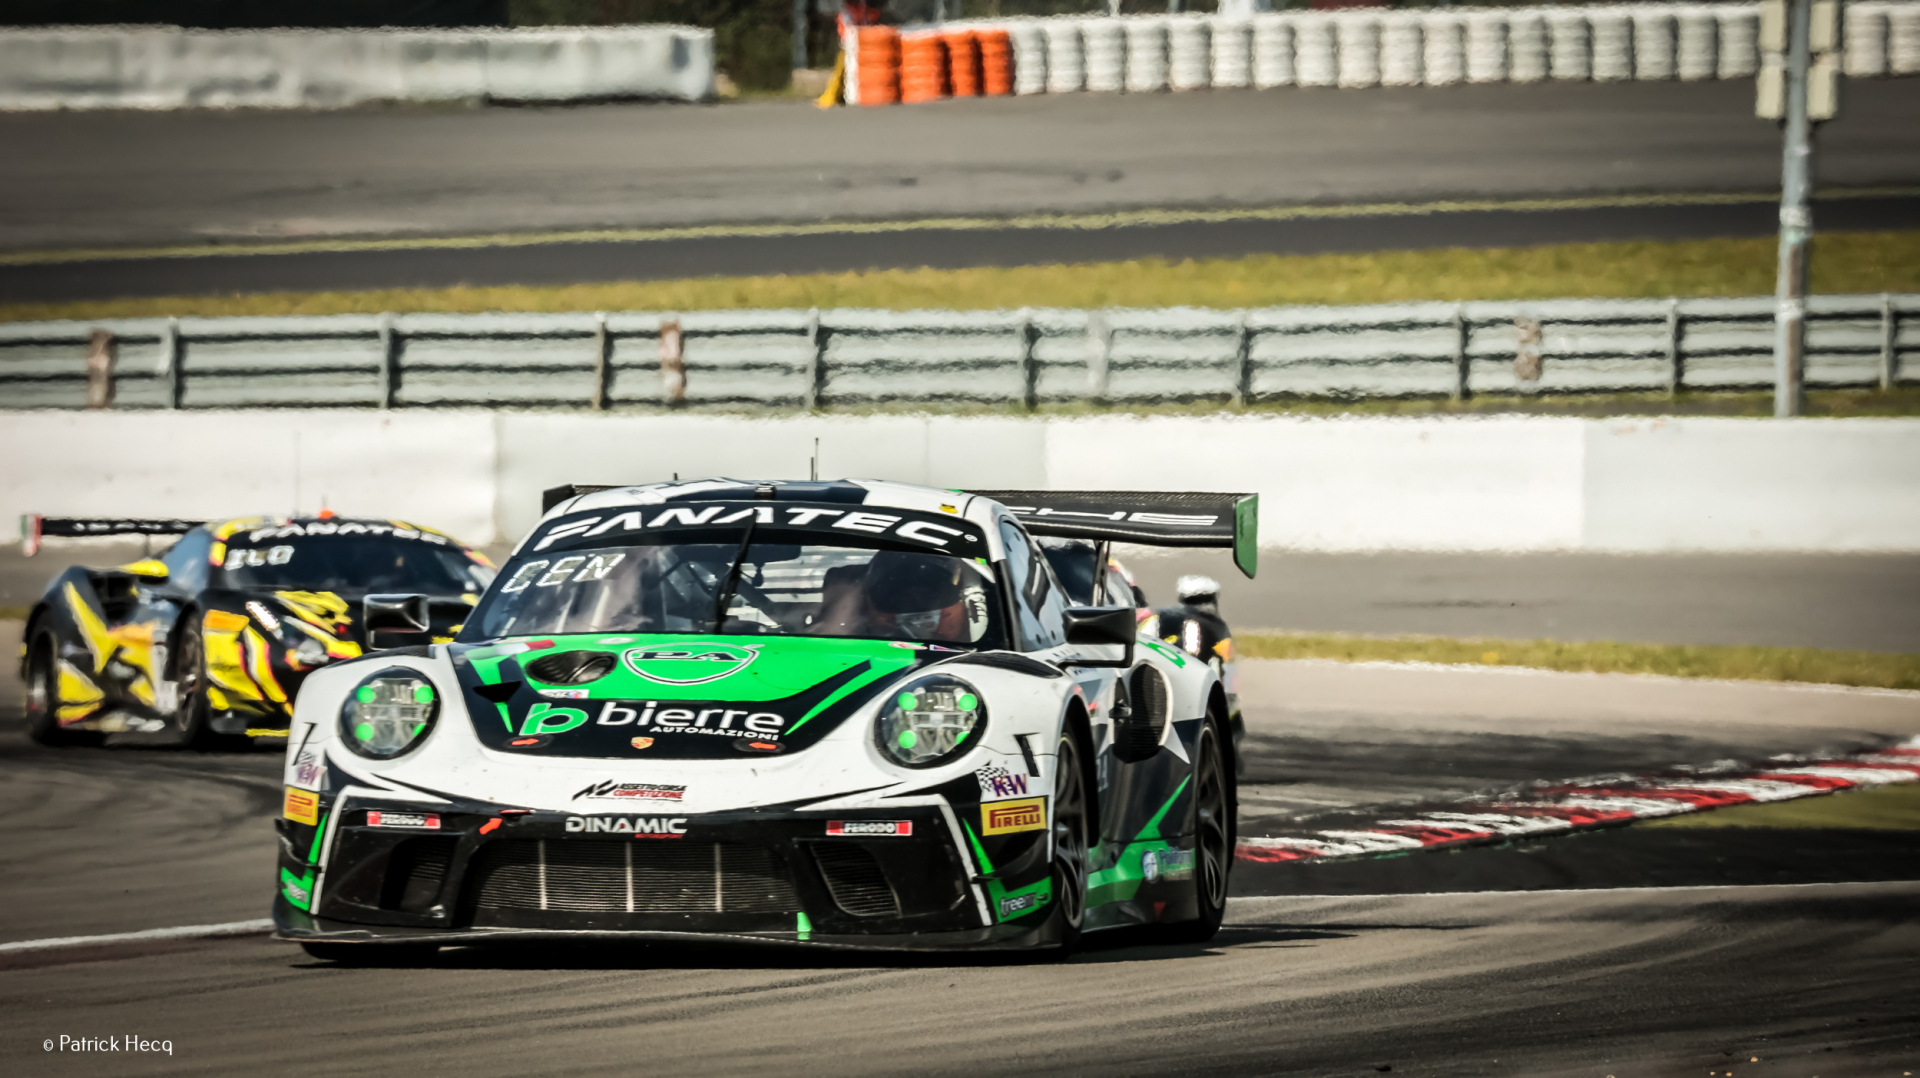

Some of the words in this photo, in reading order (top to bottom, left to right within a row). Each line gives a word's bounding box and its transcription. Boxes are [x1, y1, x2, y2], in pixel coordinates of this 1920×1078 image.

[250, 522, 447, 546] FANATEC
[533, 506, 964, 552] FANATEC
[596, 701, 785, 733] bierre
[649, 726, 779, 741] AUTOMAZIONI
[990, 774, 1028, 797] KW
[565, 816, 688, 834] DINAMIC
[843, 821, 896, 834] FERODO
[989, 804, 1041, 829] PIRELLI
